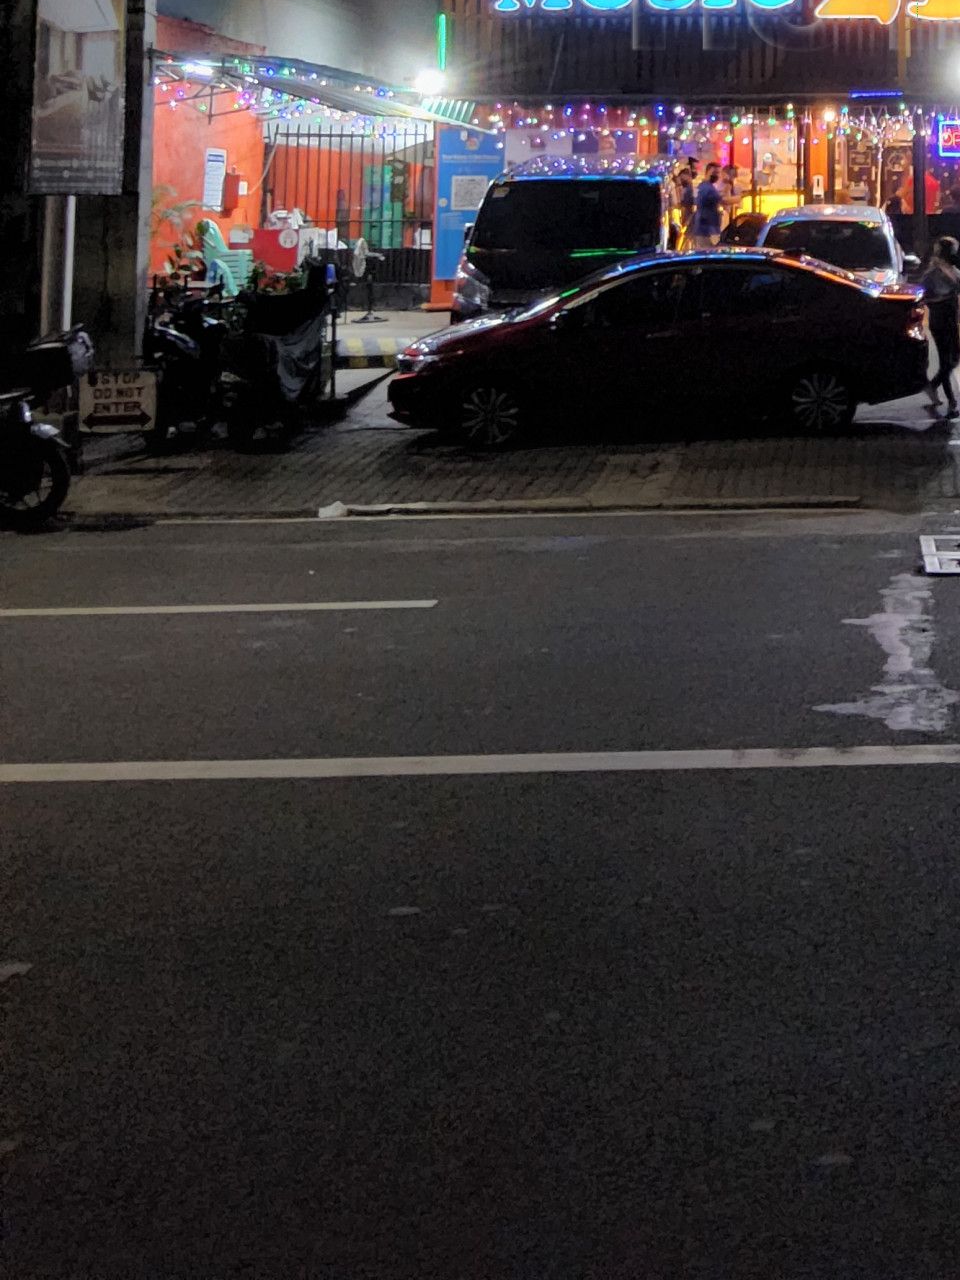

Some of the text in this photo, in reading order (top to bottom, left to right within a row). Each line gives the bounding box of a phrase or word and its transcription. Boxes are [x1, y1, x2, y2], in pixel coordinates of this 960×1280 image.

[100, 372, 140, 385] STOP
[93, 386, 144, 400] DO NOT
[93, 401, 141, 414] ENTER
